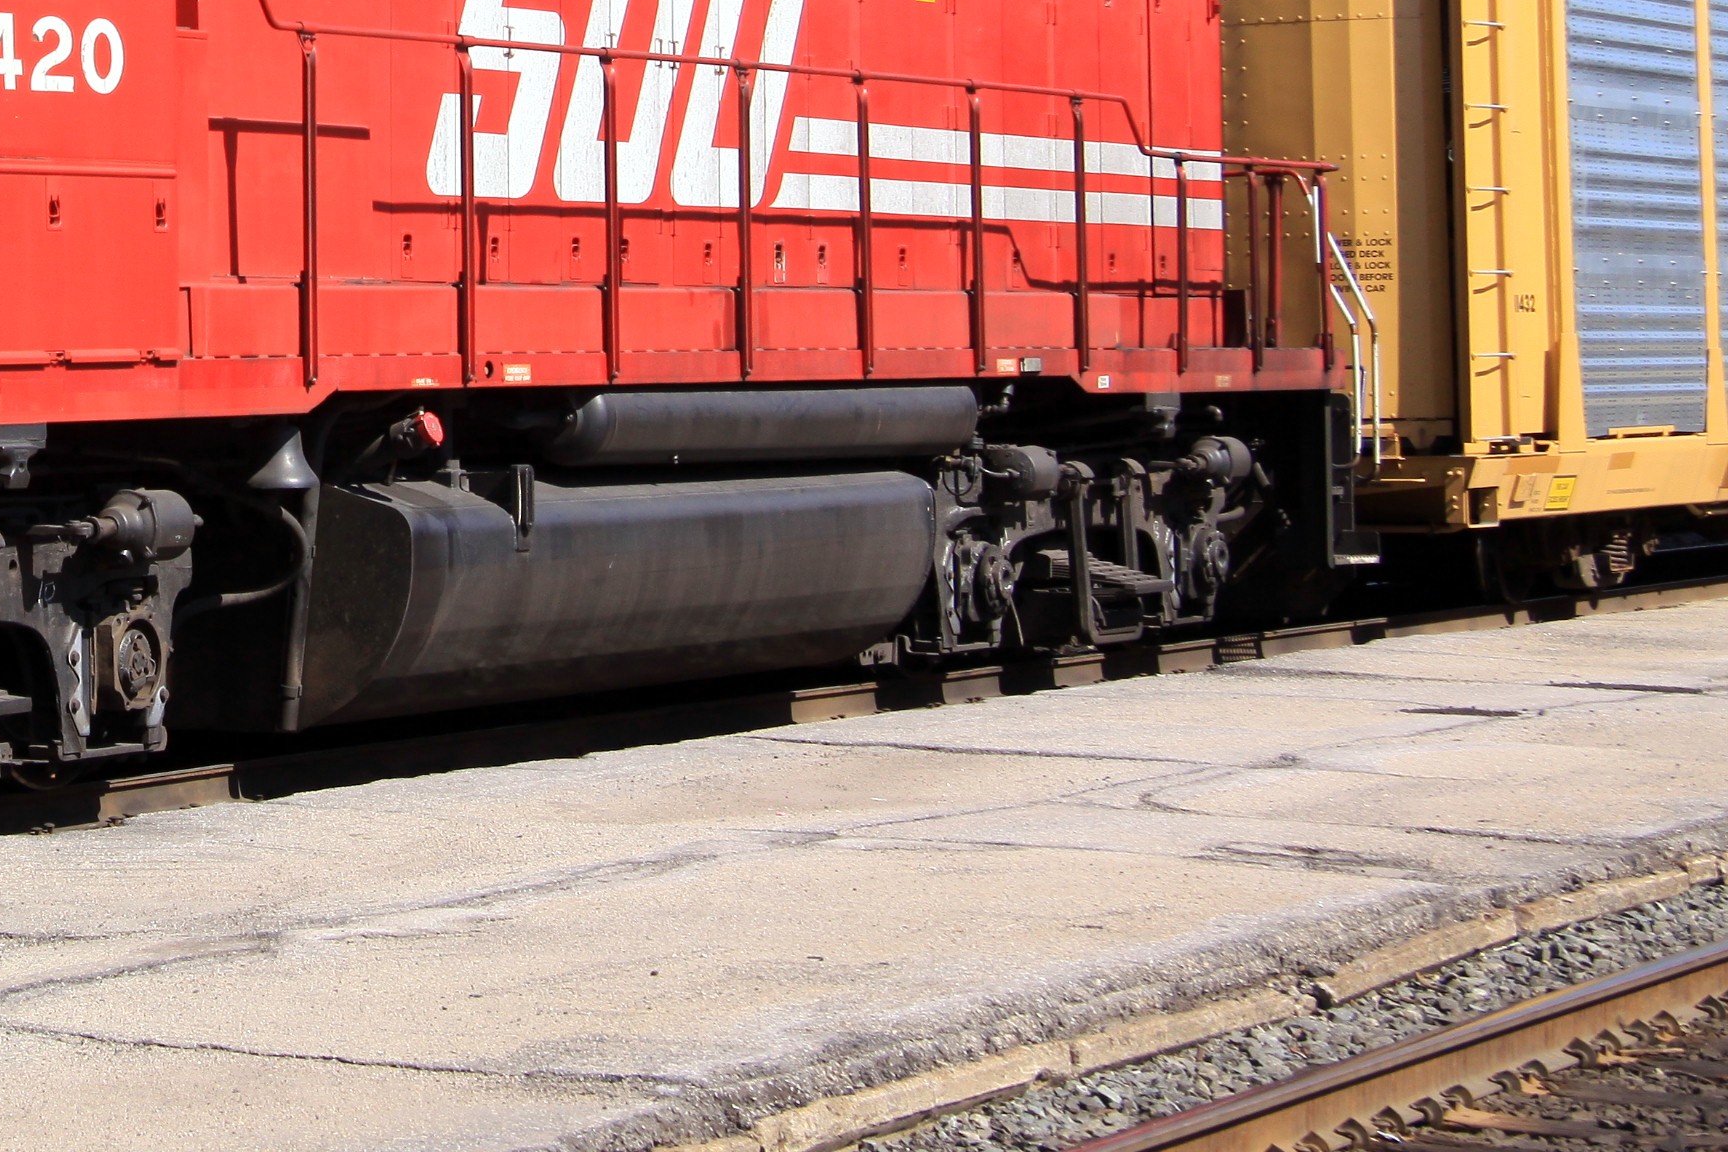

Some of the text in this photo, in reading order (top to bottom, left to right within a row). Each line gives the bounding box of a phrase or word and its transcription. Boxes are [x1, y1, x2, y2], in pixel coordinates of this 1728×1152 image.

[1366, 238, 1392, 246] LOCK
[1359, 250, 1384, 258] DECK
[1365, 261, 1391, 269] LOCK
[1359, 272, 1394, 281] BEFORE
[1365, 284, 1386, 293] CAR
